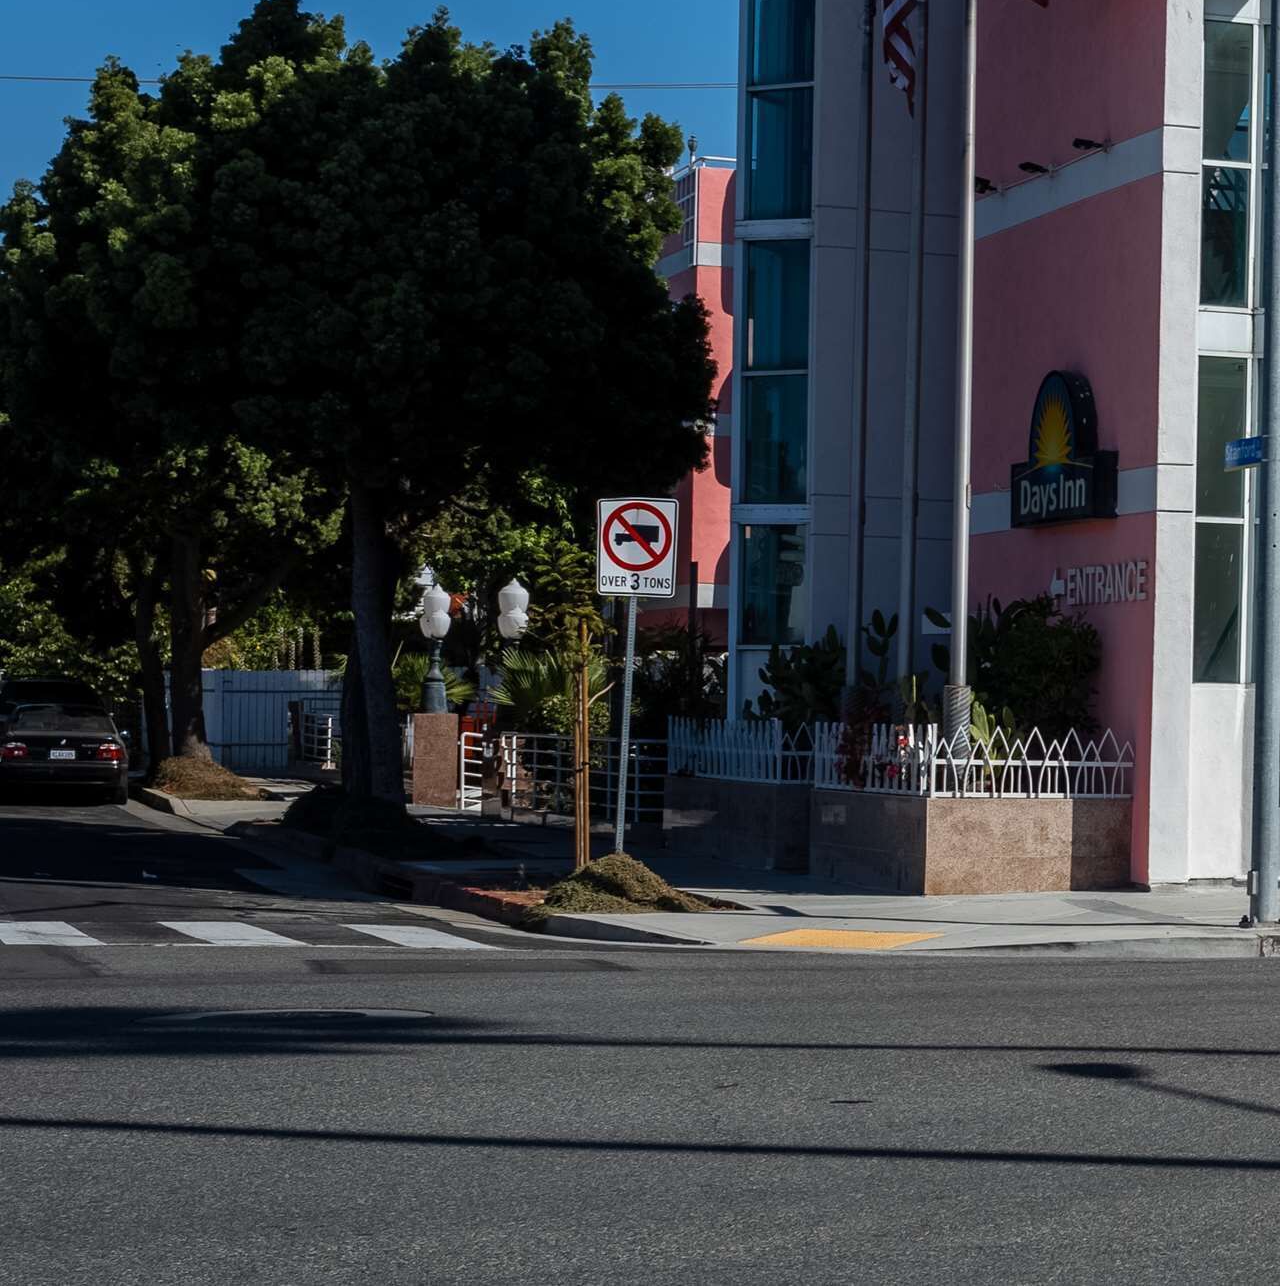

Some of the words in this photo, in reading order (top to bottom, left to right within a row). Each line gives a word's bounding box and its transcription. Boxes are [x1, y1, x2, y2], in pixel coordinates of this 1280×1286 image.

[1020, 480, 1057, 519] Days
[1059, 473, 1086, 510] Inn
[601, 575, 627, 587] OVER
[630, 573, 640, 591] 3
[643, 577, 671, 589] TONS
[1066, 561, 1147, 604] ENTRANCE
